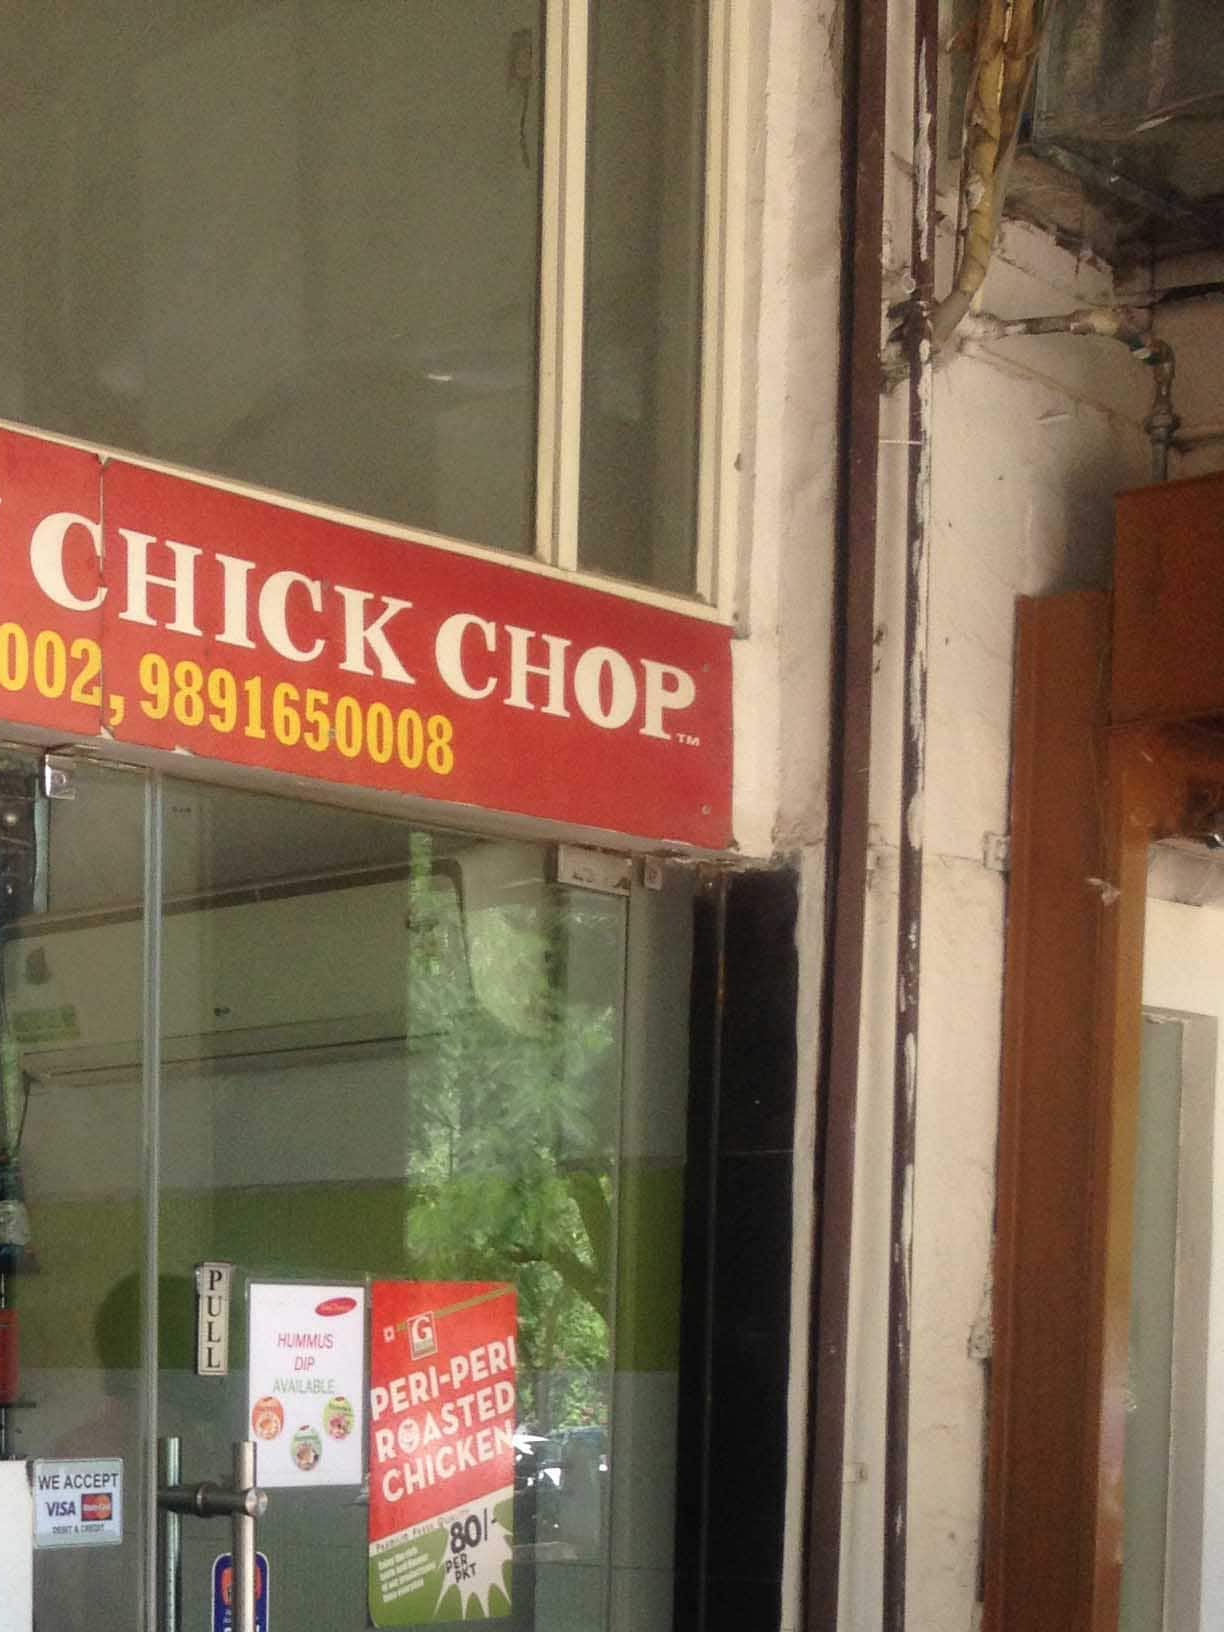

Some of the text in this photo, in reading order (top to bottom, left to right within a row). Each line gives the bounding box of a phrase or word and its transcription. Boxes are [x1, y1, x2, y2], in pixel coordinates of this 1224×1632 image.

[28, 510, 418, 686] CHICK
[434, 611, 699, 742] CHOP
[137, 651, 456, 776] 9891650008
[206, 1269, 223, 1369] PULL
[276, 1332, 335, 1350] HUMMUS
[294, 1355, 316, 1372] DIP
[272, 1378, 337, 1395] AVAILABLE
[370, 1335, 518, 1421] PERI-PERI
[375, 1380, 516, 1464] ROASTED
[381, 1418, 514, 1503] CHICKEN
[38, 1472, 119, 1491] WE ACCEPT
[45, 1500, 76, 1517] VISA
[445, 1553, 468, 1574] PER
[455, 1563, 477, 1583] PKT
